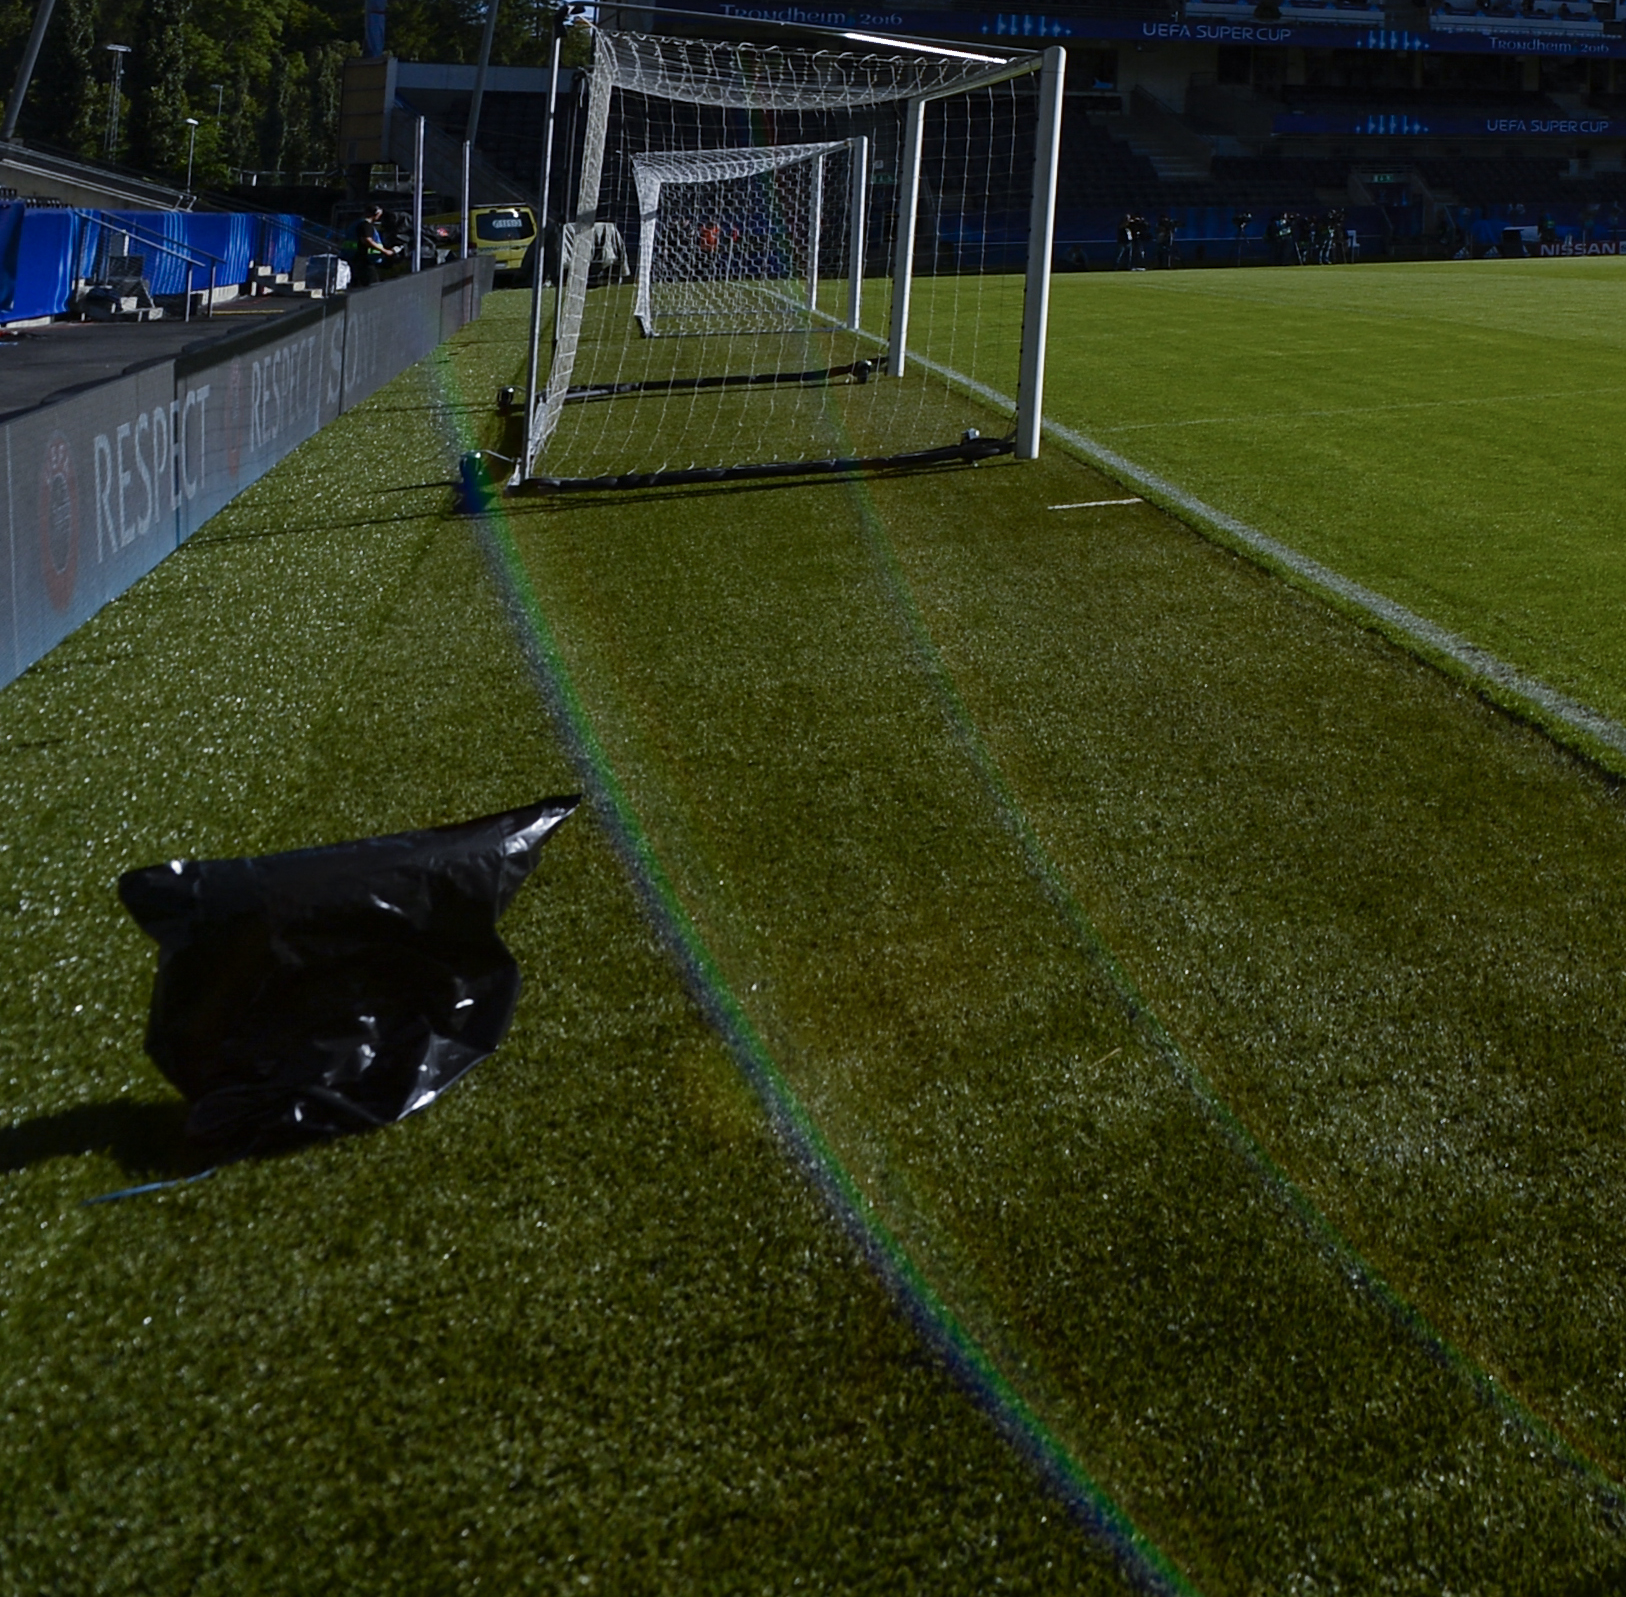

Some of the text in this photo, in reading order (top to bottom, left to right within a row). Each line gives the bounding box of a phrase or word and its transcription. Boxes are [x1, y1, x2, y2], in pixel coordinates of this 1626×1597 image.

[859, 12, 903, 26] 2016
[1142, 22, 1292, 42] UEFA SUPER CUP
[1580, 43, 1610, 53] 2016
[1486, 119, 1609, 133] UEFA SUPER CUP
[1540, 242, 1616, 256] NISSAN
[250, 335, 316, 453] RESPECT
[94, 384, 211, 564] RESPECT
